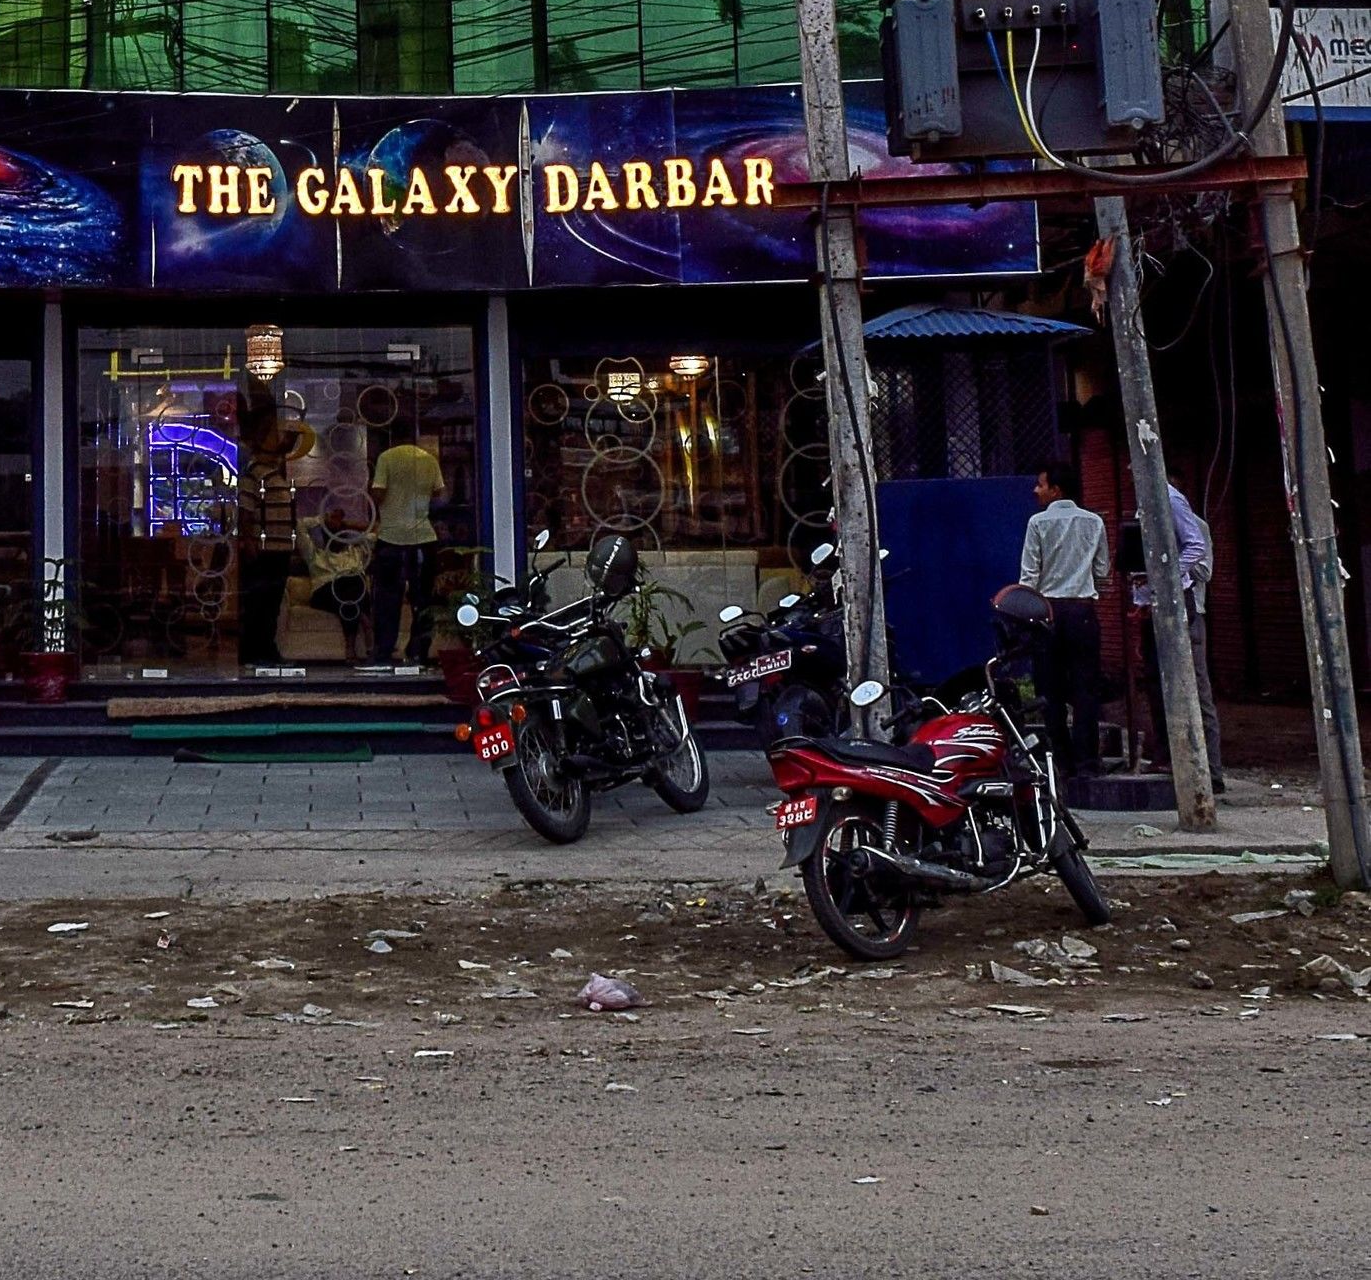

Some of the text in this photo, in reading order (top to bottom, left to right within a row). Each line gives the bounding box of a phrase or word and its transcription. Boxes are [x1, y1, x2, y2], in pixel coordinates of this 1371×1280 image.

[171, 156, 775, 216] THE GALAXY DARBAR
